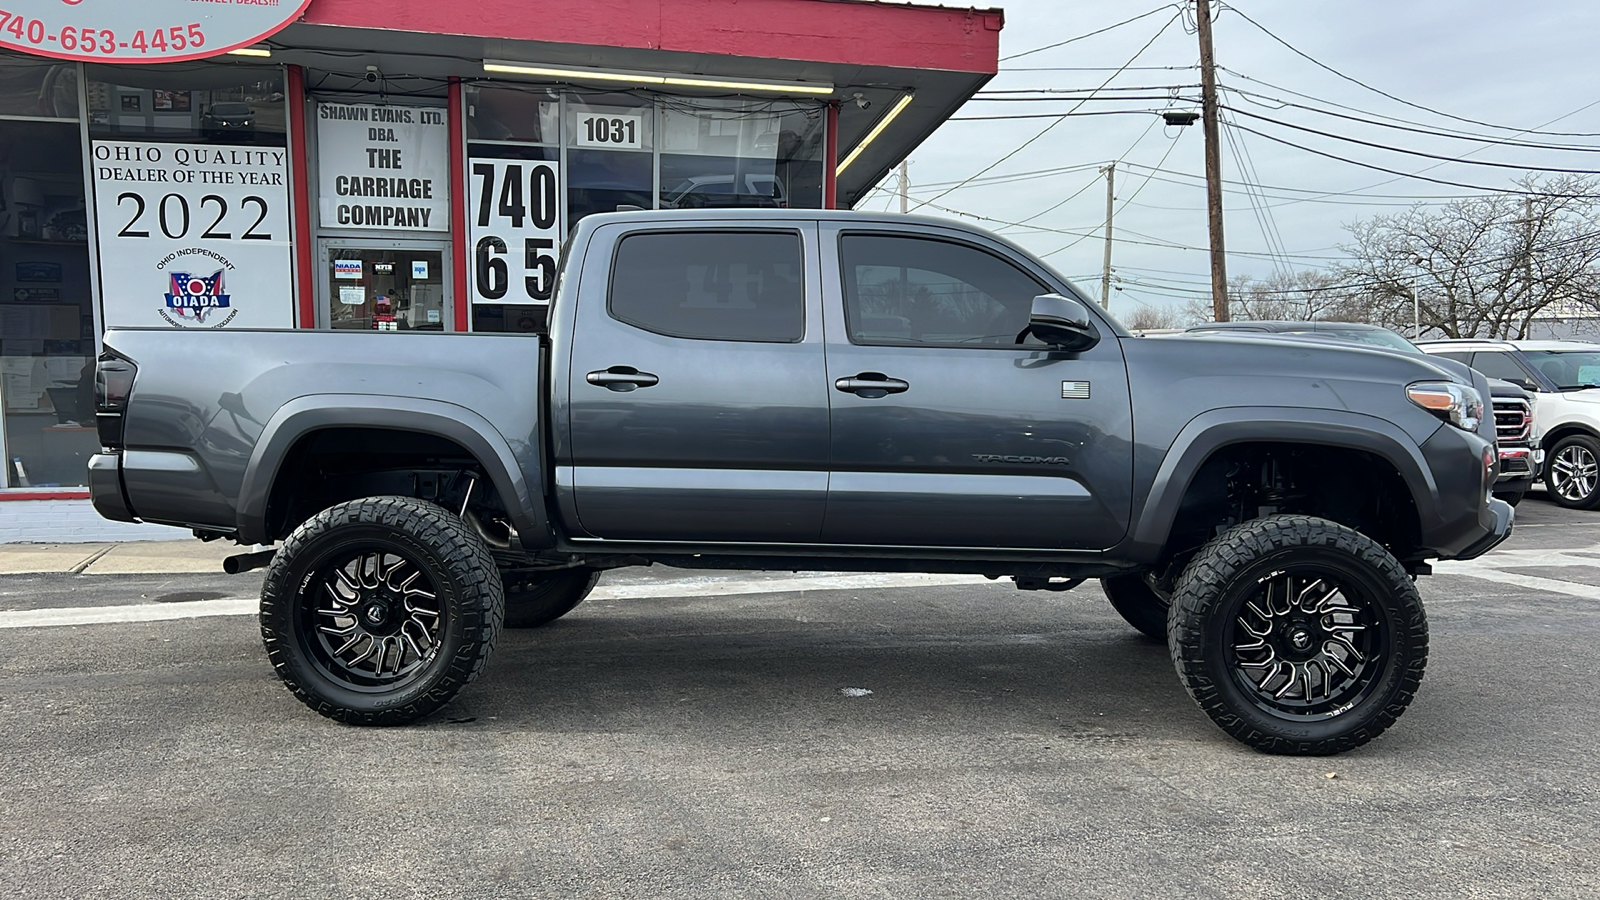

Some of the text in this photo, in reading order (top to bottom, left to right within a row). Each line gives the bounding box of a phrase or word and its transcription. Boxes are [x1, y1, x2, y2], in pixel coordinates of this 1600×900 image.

[0, 10, 205, 54] 740-653-4455
[320, 106, 445, 125] SHAWN EVANS. LTD.
[368, 127, 399, 142] DBA.
[583, 117, 635, 144] 1031
[95, 145, 285, 166] OHIO QUALITY
[365, 148, 402, 169] THE
[99, 167, 283, 186] DEALER OF THE YEAR
[335, 175, 432, 200] CARRIAGE
[473, 162, 556, 230] 740
[117, 191, 272, 240] 2022
[337, 204, 431, 227] COMPANY
[156, 247, 236, 271] OHIO INDEPENDENT
[172, 295, 220, 307] OIADA
[972, 454, 1070, 465] TACOMA
[298, 570, 315, 595] FUEL
[1257, 569, 1286, 584] FUEL
[1325, 702, 1354, 717] FUEL
